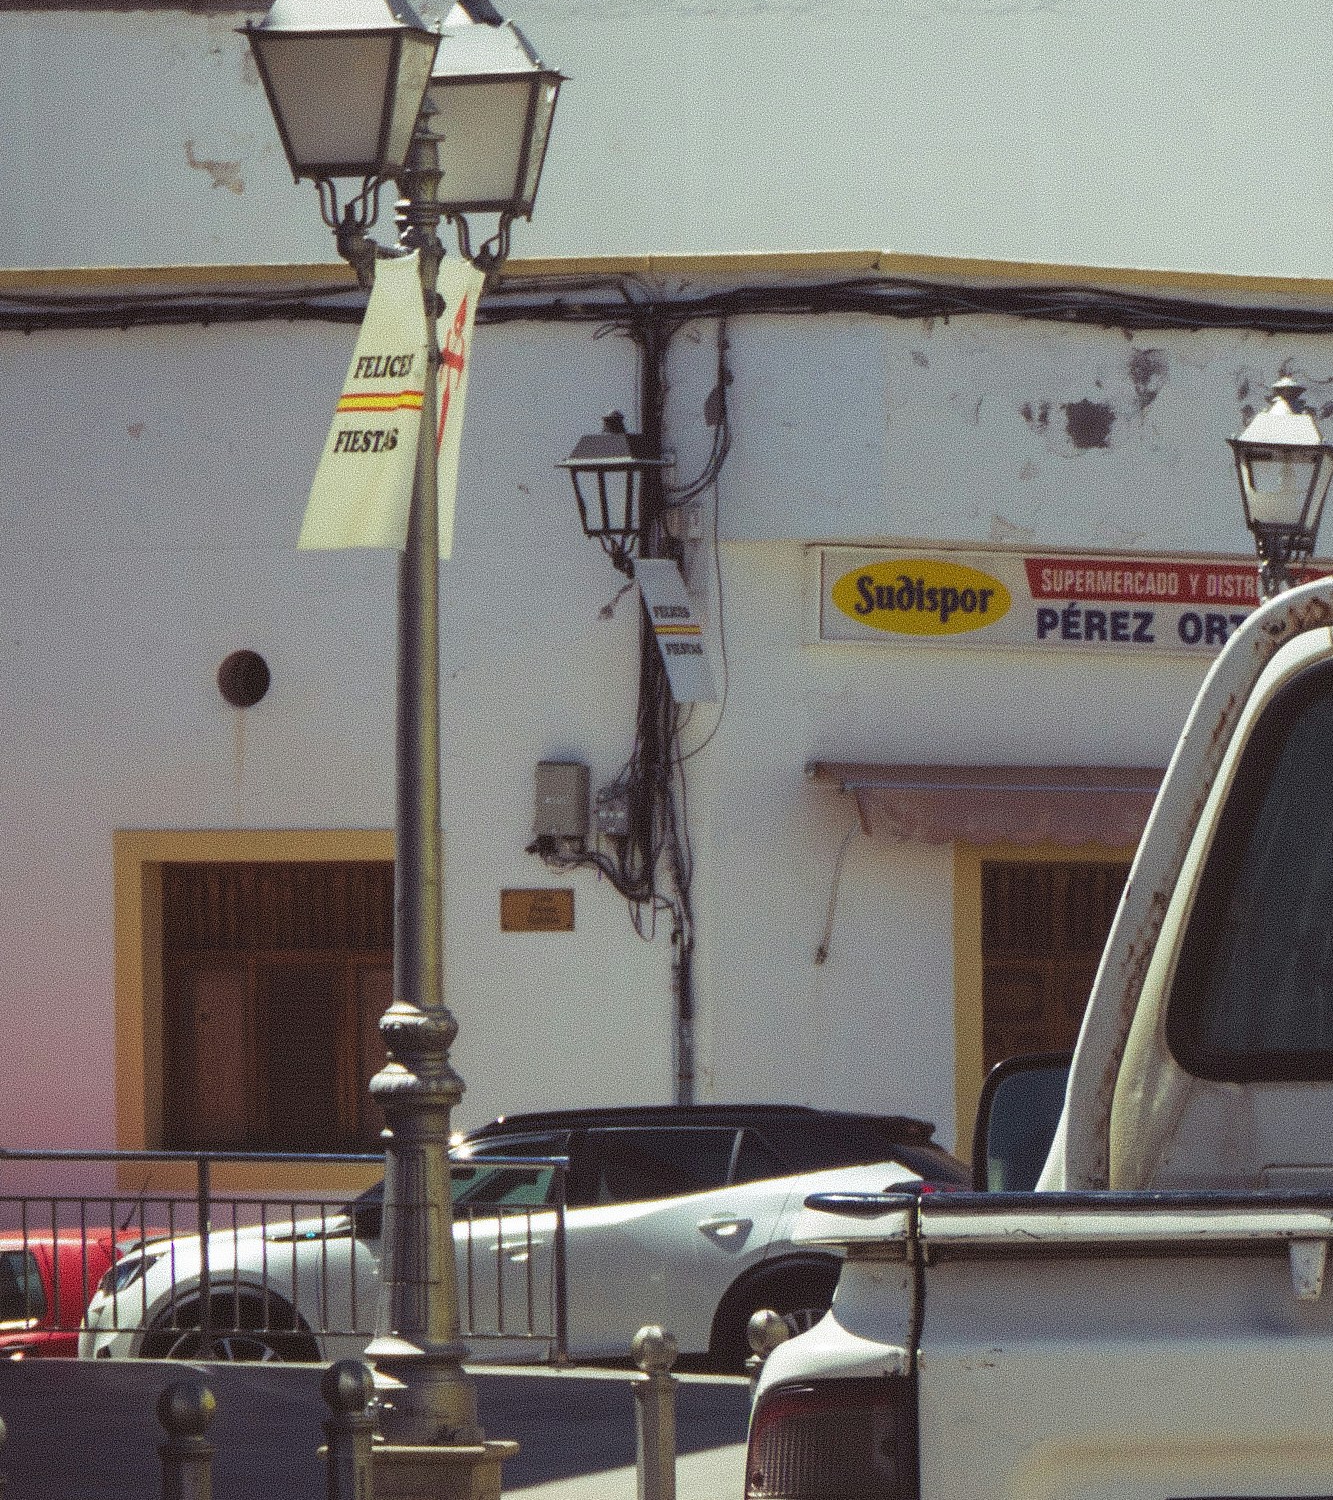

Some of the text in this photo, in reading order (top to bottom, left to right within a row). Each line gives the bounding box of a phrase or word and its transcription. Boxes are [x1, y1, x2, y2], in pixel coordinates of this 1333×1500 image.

[333, 427, 399, 454] FIESTAS
[855, 574, 995, 624] Sudispor
[1041, 568, 1179, 596] SUPERMERCADO
[1189, 573, 1200, 597] Y
[1036, 601, 1155, 644] PÉREZ
